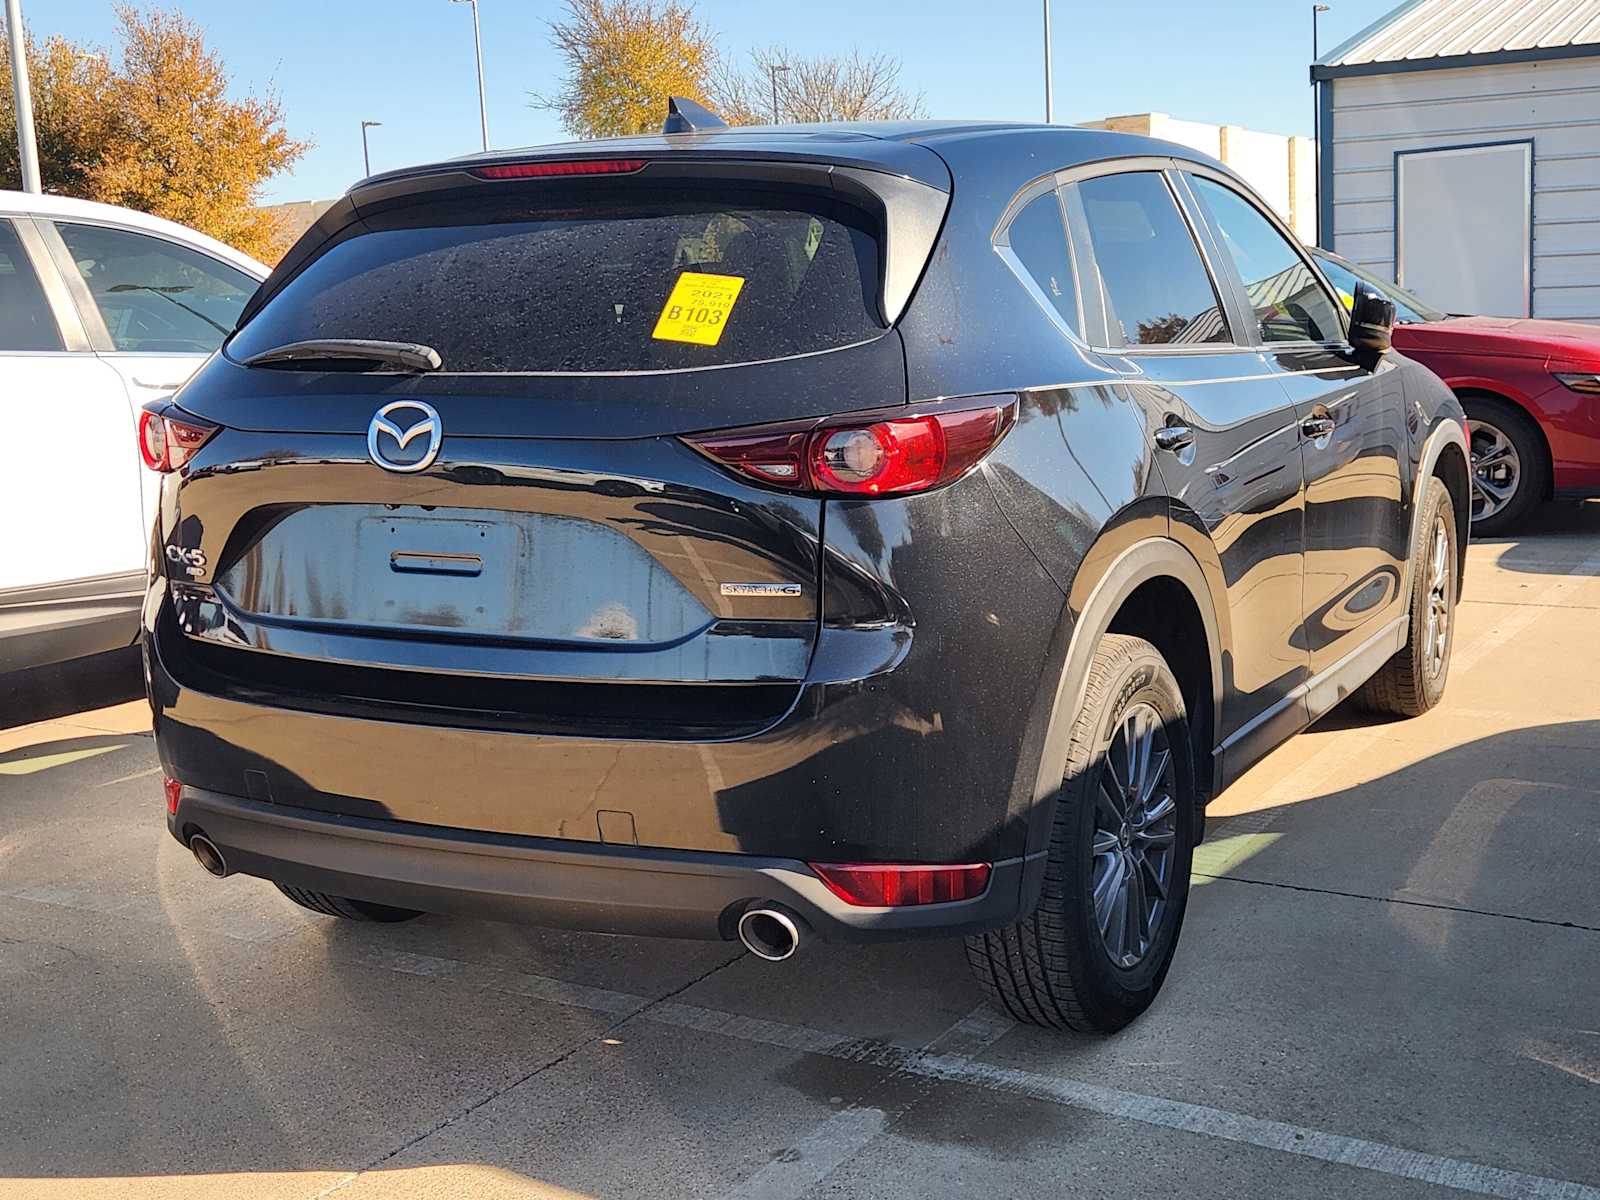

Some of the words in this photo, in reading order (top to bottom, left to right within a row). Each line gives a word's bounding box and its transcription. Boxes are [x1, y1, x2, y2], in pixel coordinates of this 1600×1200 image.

[691, 289, 732, 300] 2021
[668, 305, 723, 325] B103
[166, 544, 207, 567] CX-5
